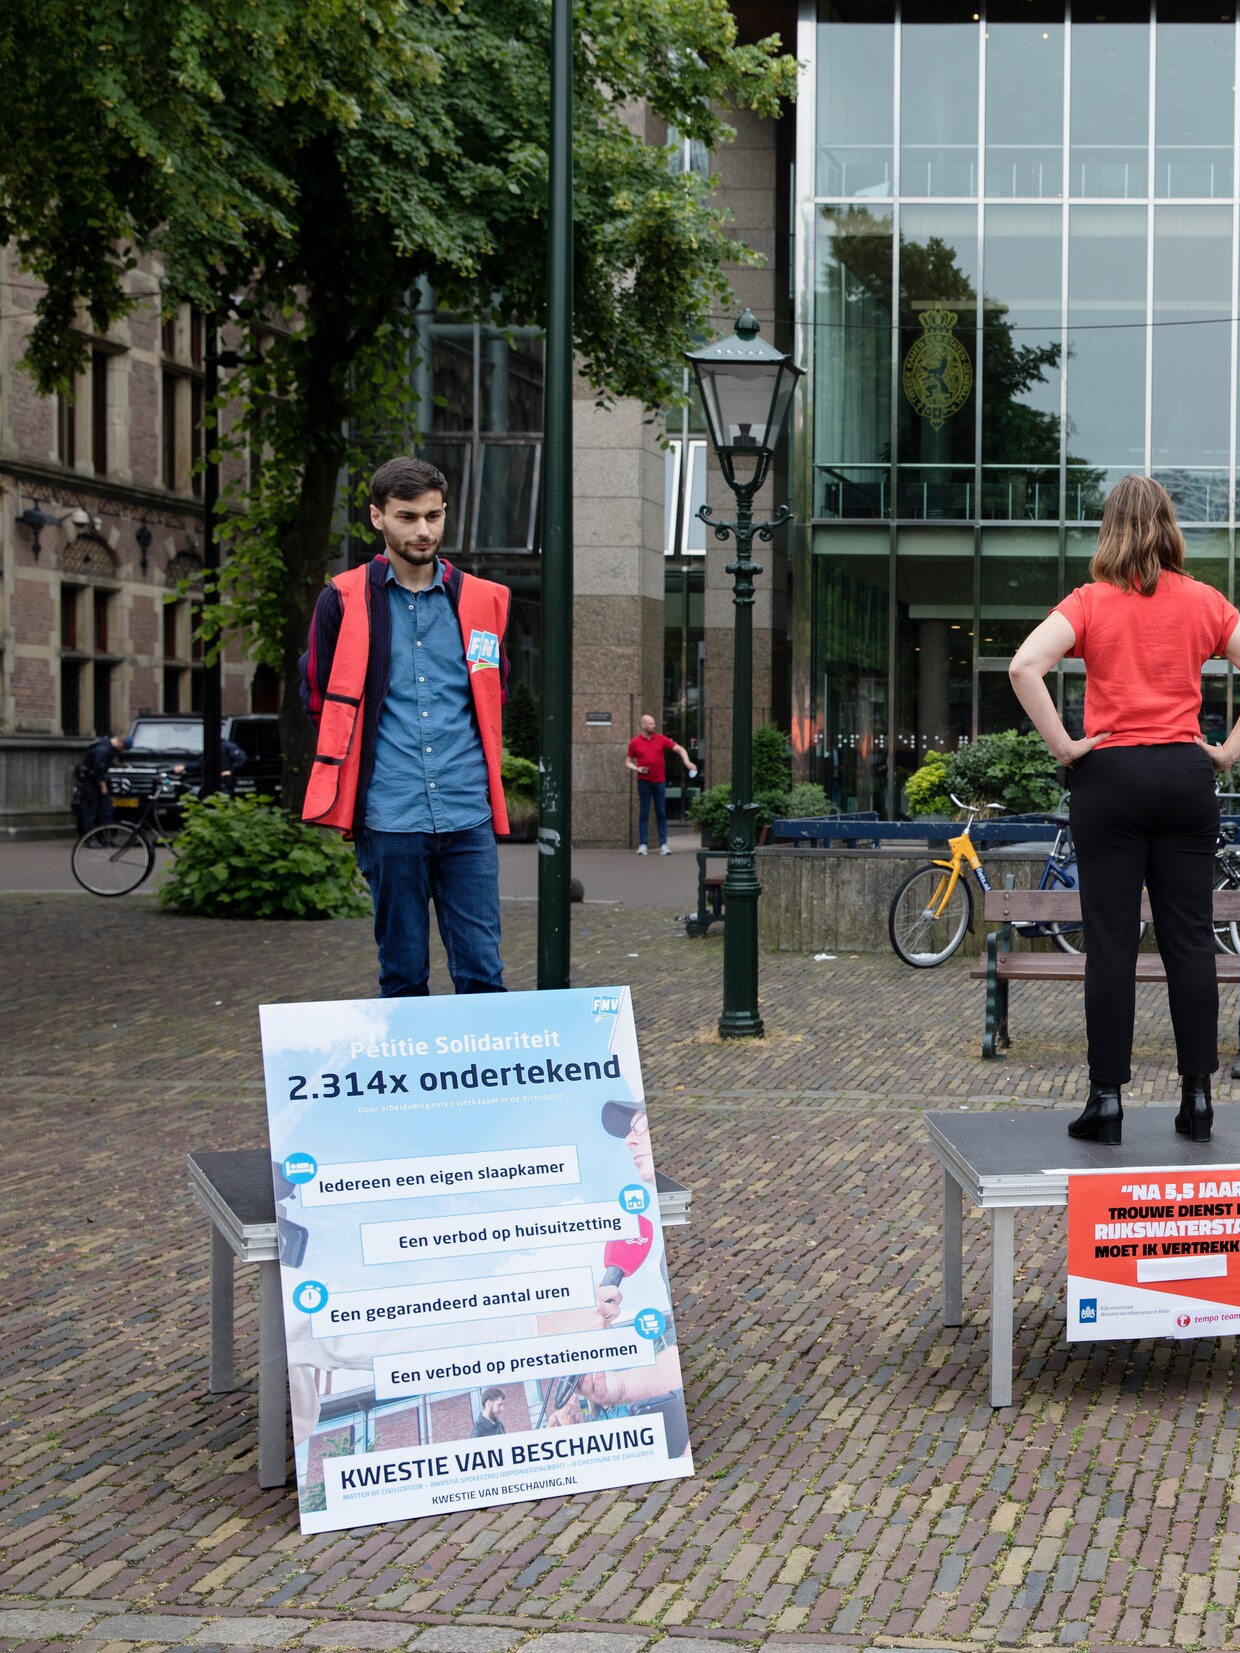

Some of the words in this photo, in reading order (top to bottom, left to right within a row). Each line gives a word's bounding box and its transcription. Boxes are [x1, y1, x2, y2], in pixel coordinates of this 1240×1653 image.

[593, 999, 619, 1012] FNV
[351, 1037, 429, 1060] Petitie
[436, 1030, 560, 1054] Solidariteit
[288, 1070, 409, 1101] 2.314x
[420, 1055, 621, 1092] ondertekend
[358, 1105, 378, 1114] Door
[457, 1098, 498, 1107] werkzaam
[500, 1096, 508, 1104] in
[510, 1094, 520, 1103] de
[522, 1092, 564, 1102] distributie
[319, 1174, 391, 1194] Iedereen
[396, 1170, 425, 1187] een
[430, 1167, 474, 1187] eigen
[478, 1160, 565, 1184] slaapkamer
[1165, 1183, 1194, 1202] 5,5
[1109, 1205, 1174, 1220] TROUWE
[1178, 1203, 1233, 1217] DIENST
[399, 1233, 429, 1249] Een
[433, 1226, 488, 1246] verbod
[492, 1227, 511, 1245] op
[515, 1215, 622, 1241] huisuitzetting
[1095, 1244, 1138, 1258] MOET
[1143, 1243, 1158, 1256] IK
[330, 1307, 361, 1324] Een
[366, 1295, 478, 1322] gegarandeerd
[482, 1287, 531, 1307] aantal
[535, 1284, 570, 1301] uren
[1194, 1314, 1219, 1324] tempo
[1221, 1312, 1240, 1321] team
[391, 1368, 421, 1385] Een
[426, 1359, 481, 1381] verbod
[486, 1359, 506, 1378] op
[510, 1342, 638, 1373] prestatienormen
[341, 1456, 449, 1490] KWESTIE
[455, 1448, 504, 1473] VAN
[512, 1427, 655, 1465] BESCHAVING
[343, 1491, 370, 1501] MATTER
[381, 1484, 423, 1495] CIVILIZATION
[430, 1478, 459, 1488] KWESTIA
[432, 1490, 476, 1505] KWESTIE
[478, 1486, 499, 1499] VAN
[501, 1476, 578, 1496] BESCHAVING.NL
